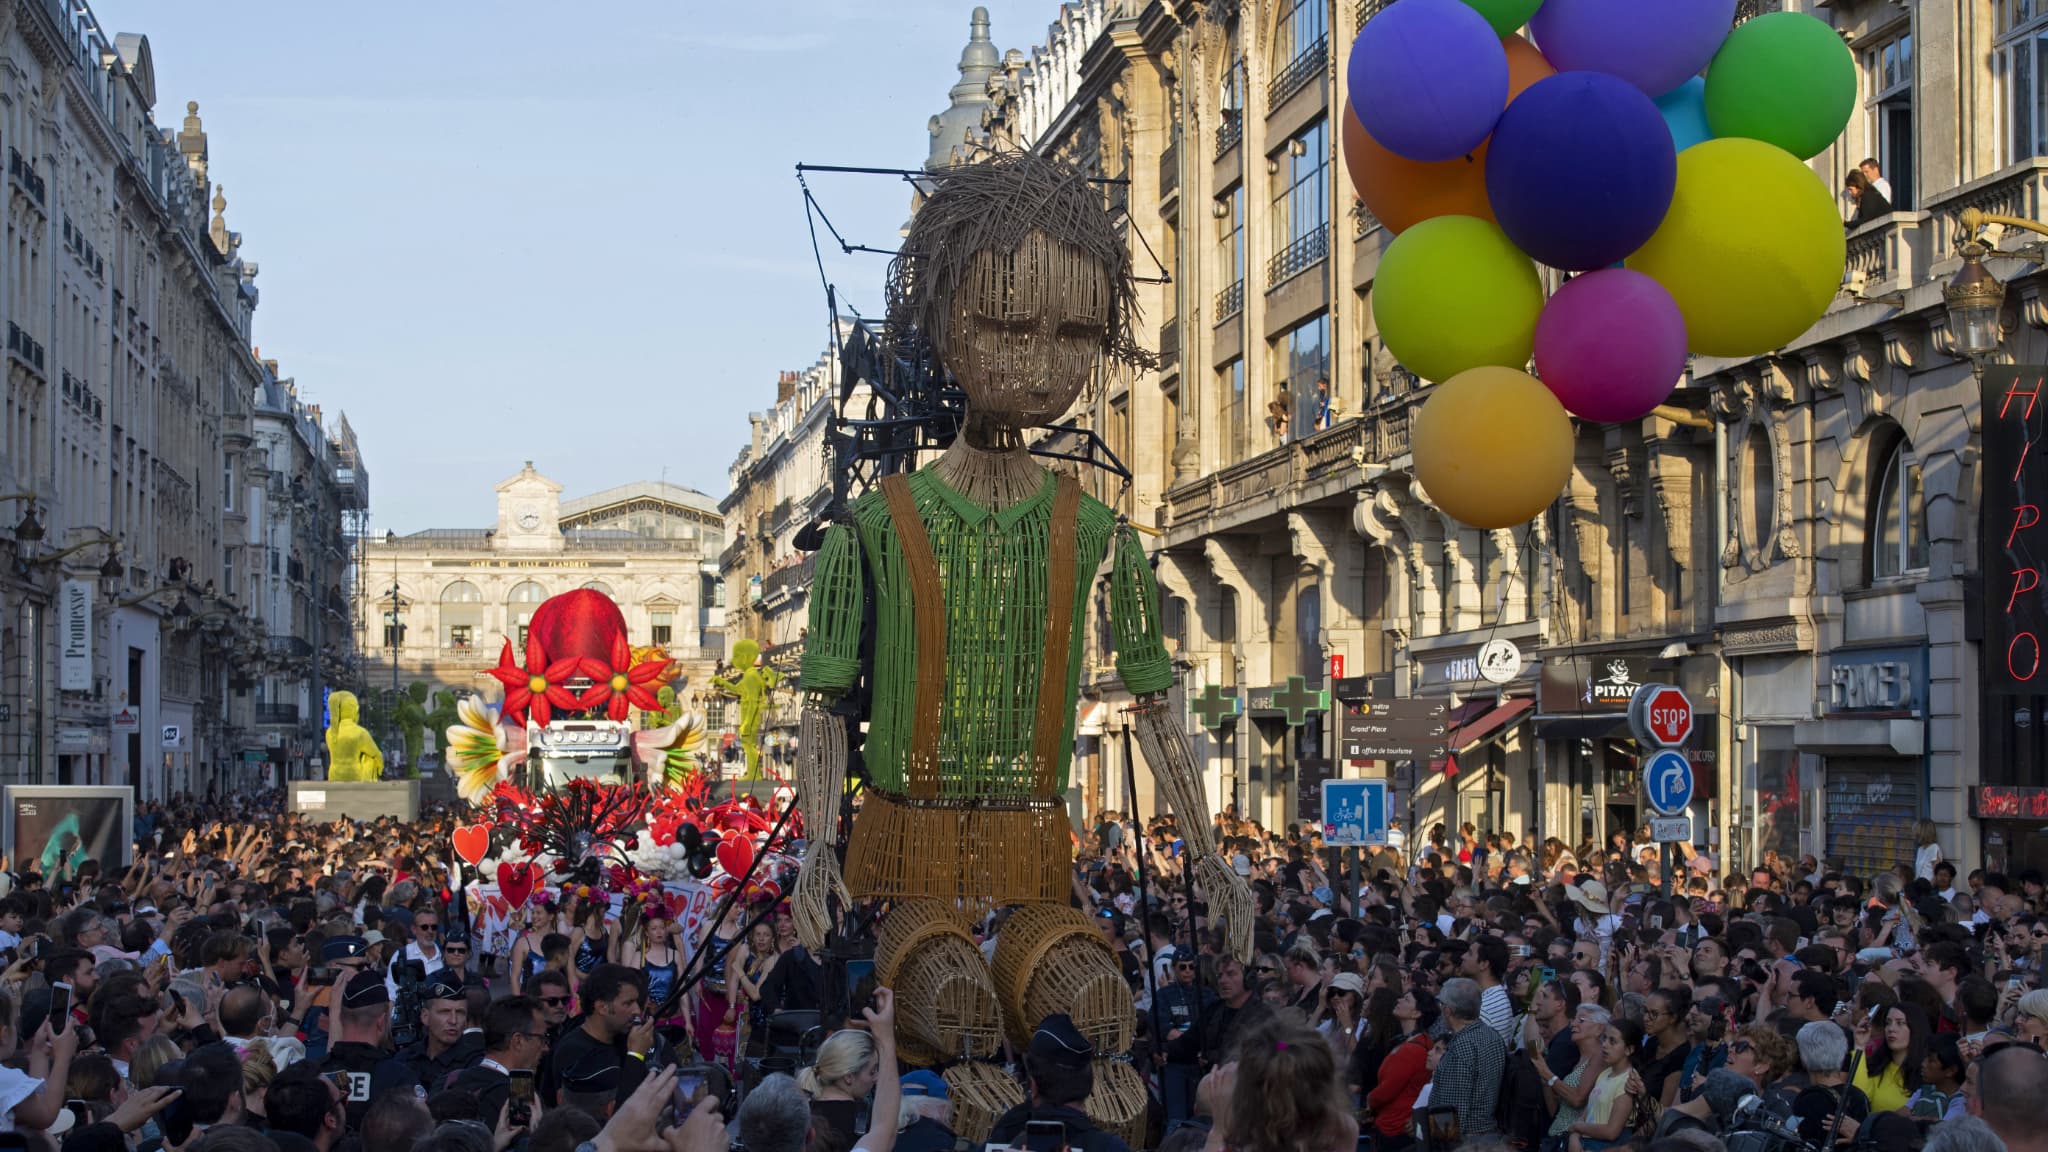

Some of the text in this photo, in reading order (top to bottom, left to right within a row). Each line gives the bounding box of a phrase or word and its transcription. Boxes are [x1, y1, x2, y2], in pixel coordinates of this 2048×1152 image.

[2000, 376, 2043, 681] HIPPO
[65, 588, 85, 658] Promesse
[1653, 708, 1687, 725] STOP
[1361, 746, 1378, 756] office
[1386, 747, 1413, 755] tourisme
